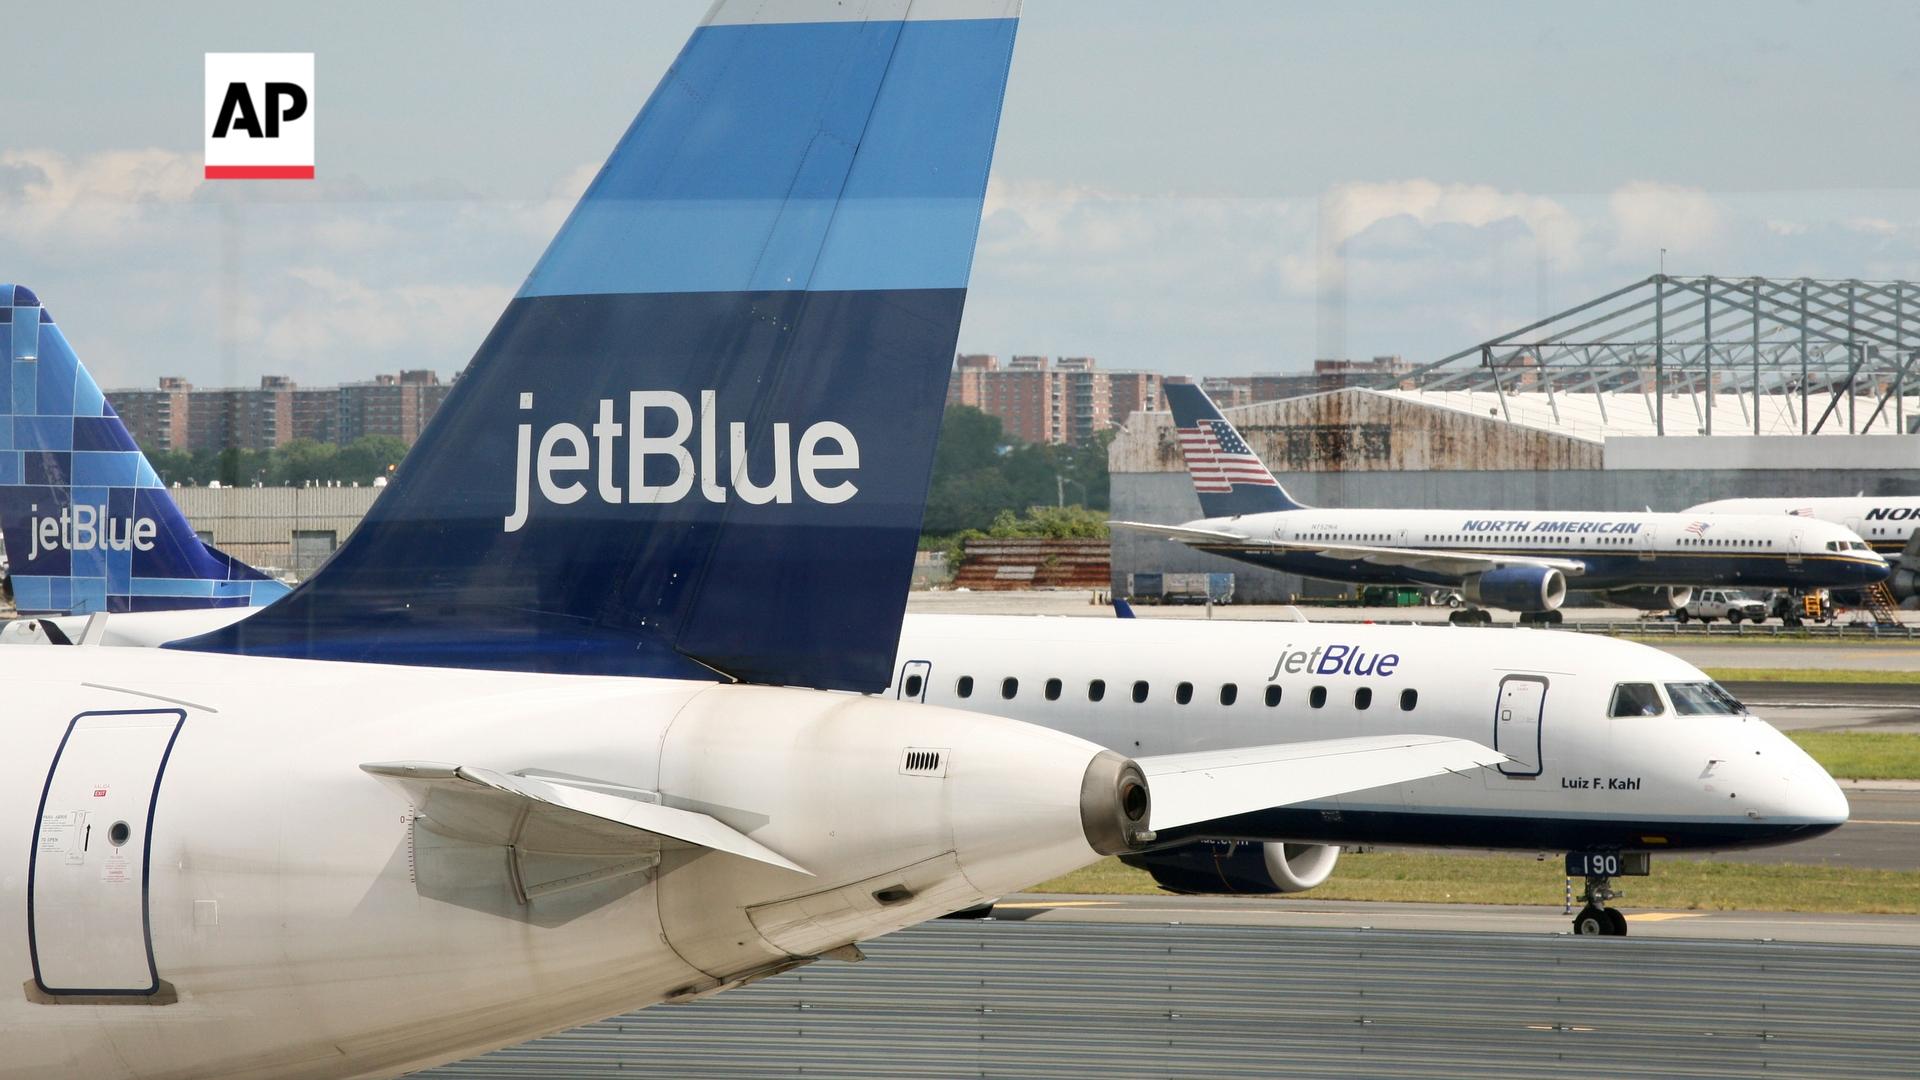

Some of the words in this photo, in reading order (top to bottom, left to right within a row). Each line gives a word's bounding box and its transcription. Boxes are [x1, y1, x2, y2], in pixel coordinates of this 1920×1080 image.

[504, 390, 860, 532] jetBlue
[28, 504, 157, 561] jetBlue
[1462, 520, 1532, 532] NORTH
[1532, 521, 1642, 534] AMERICAN
[1268, 643, 1400, 682] jetBlue
[1562, 777, 1589, 789] Luiz
[1593, 778, 1604, 789] F.
[1608, 777, 1641, 790] Kahl
[1584, 855, 1617, 874] 190
